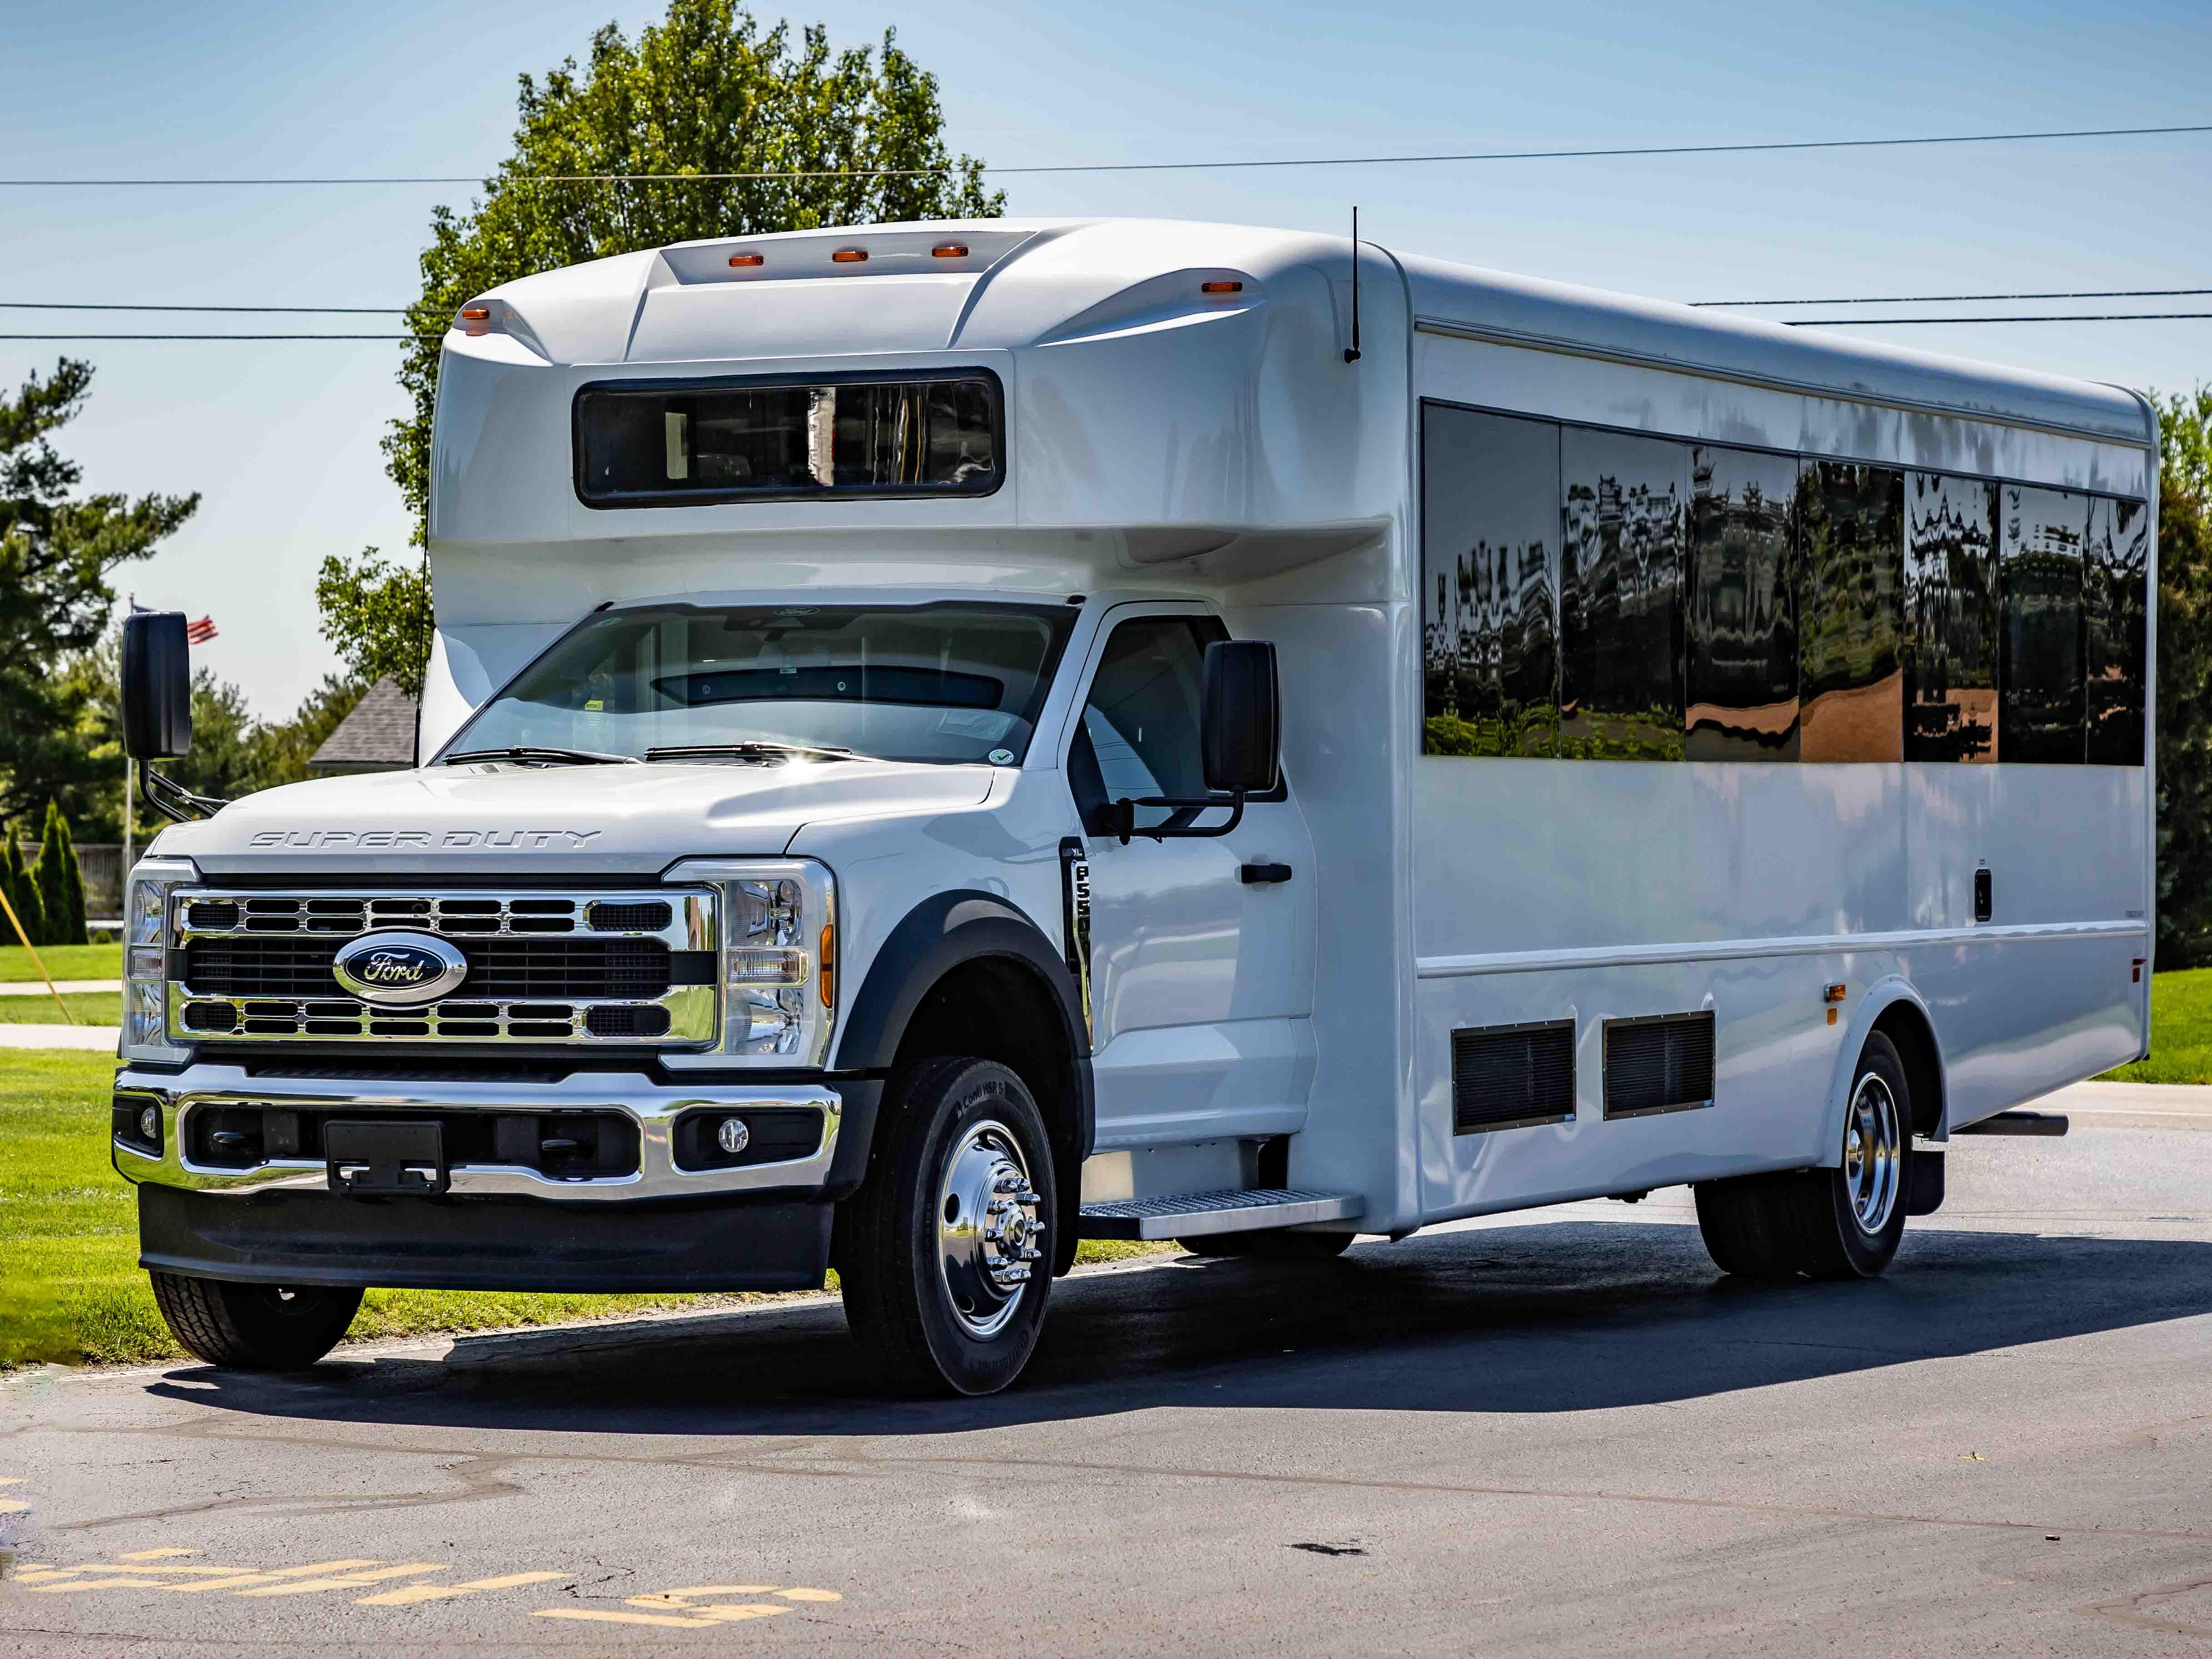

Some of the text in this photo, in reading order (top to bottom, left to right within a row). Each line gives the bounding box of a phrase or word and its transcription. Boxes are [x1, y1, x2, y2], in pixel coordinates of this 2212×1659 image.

[249, 830, 602, 849] SUPER DUTY
[364, 952, 425, 980] Ford
[963, 1084, 982, 1108] Conti
